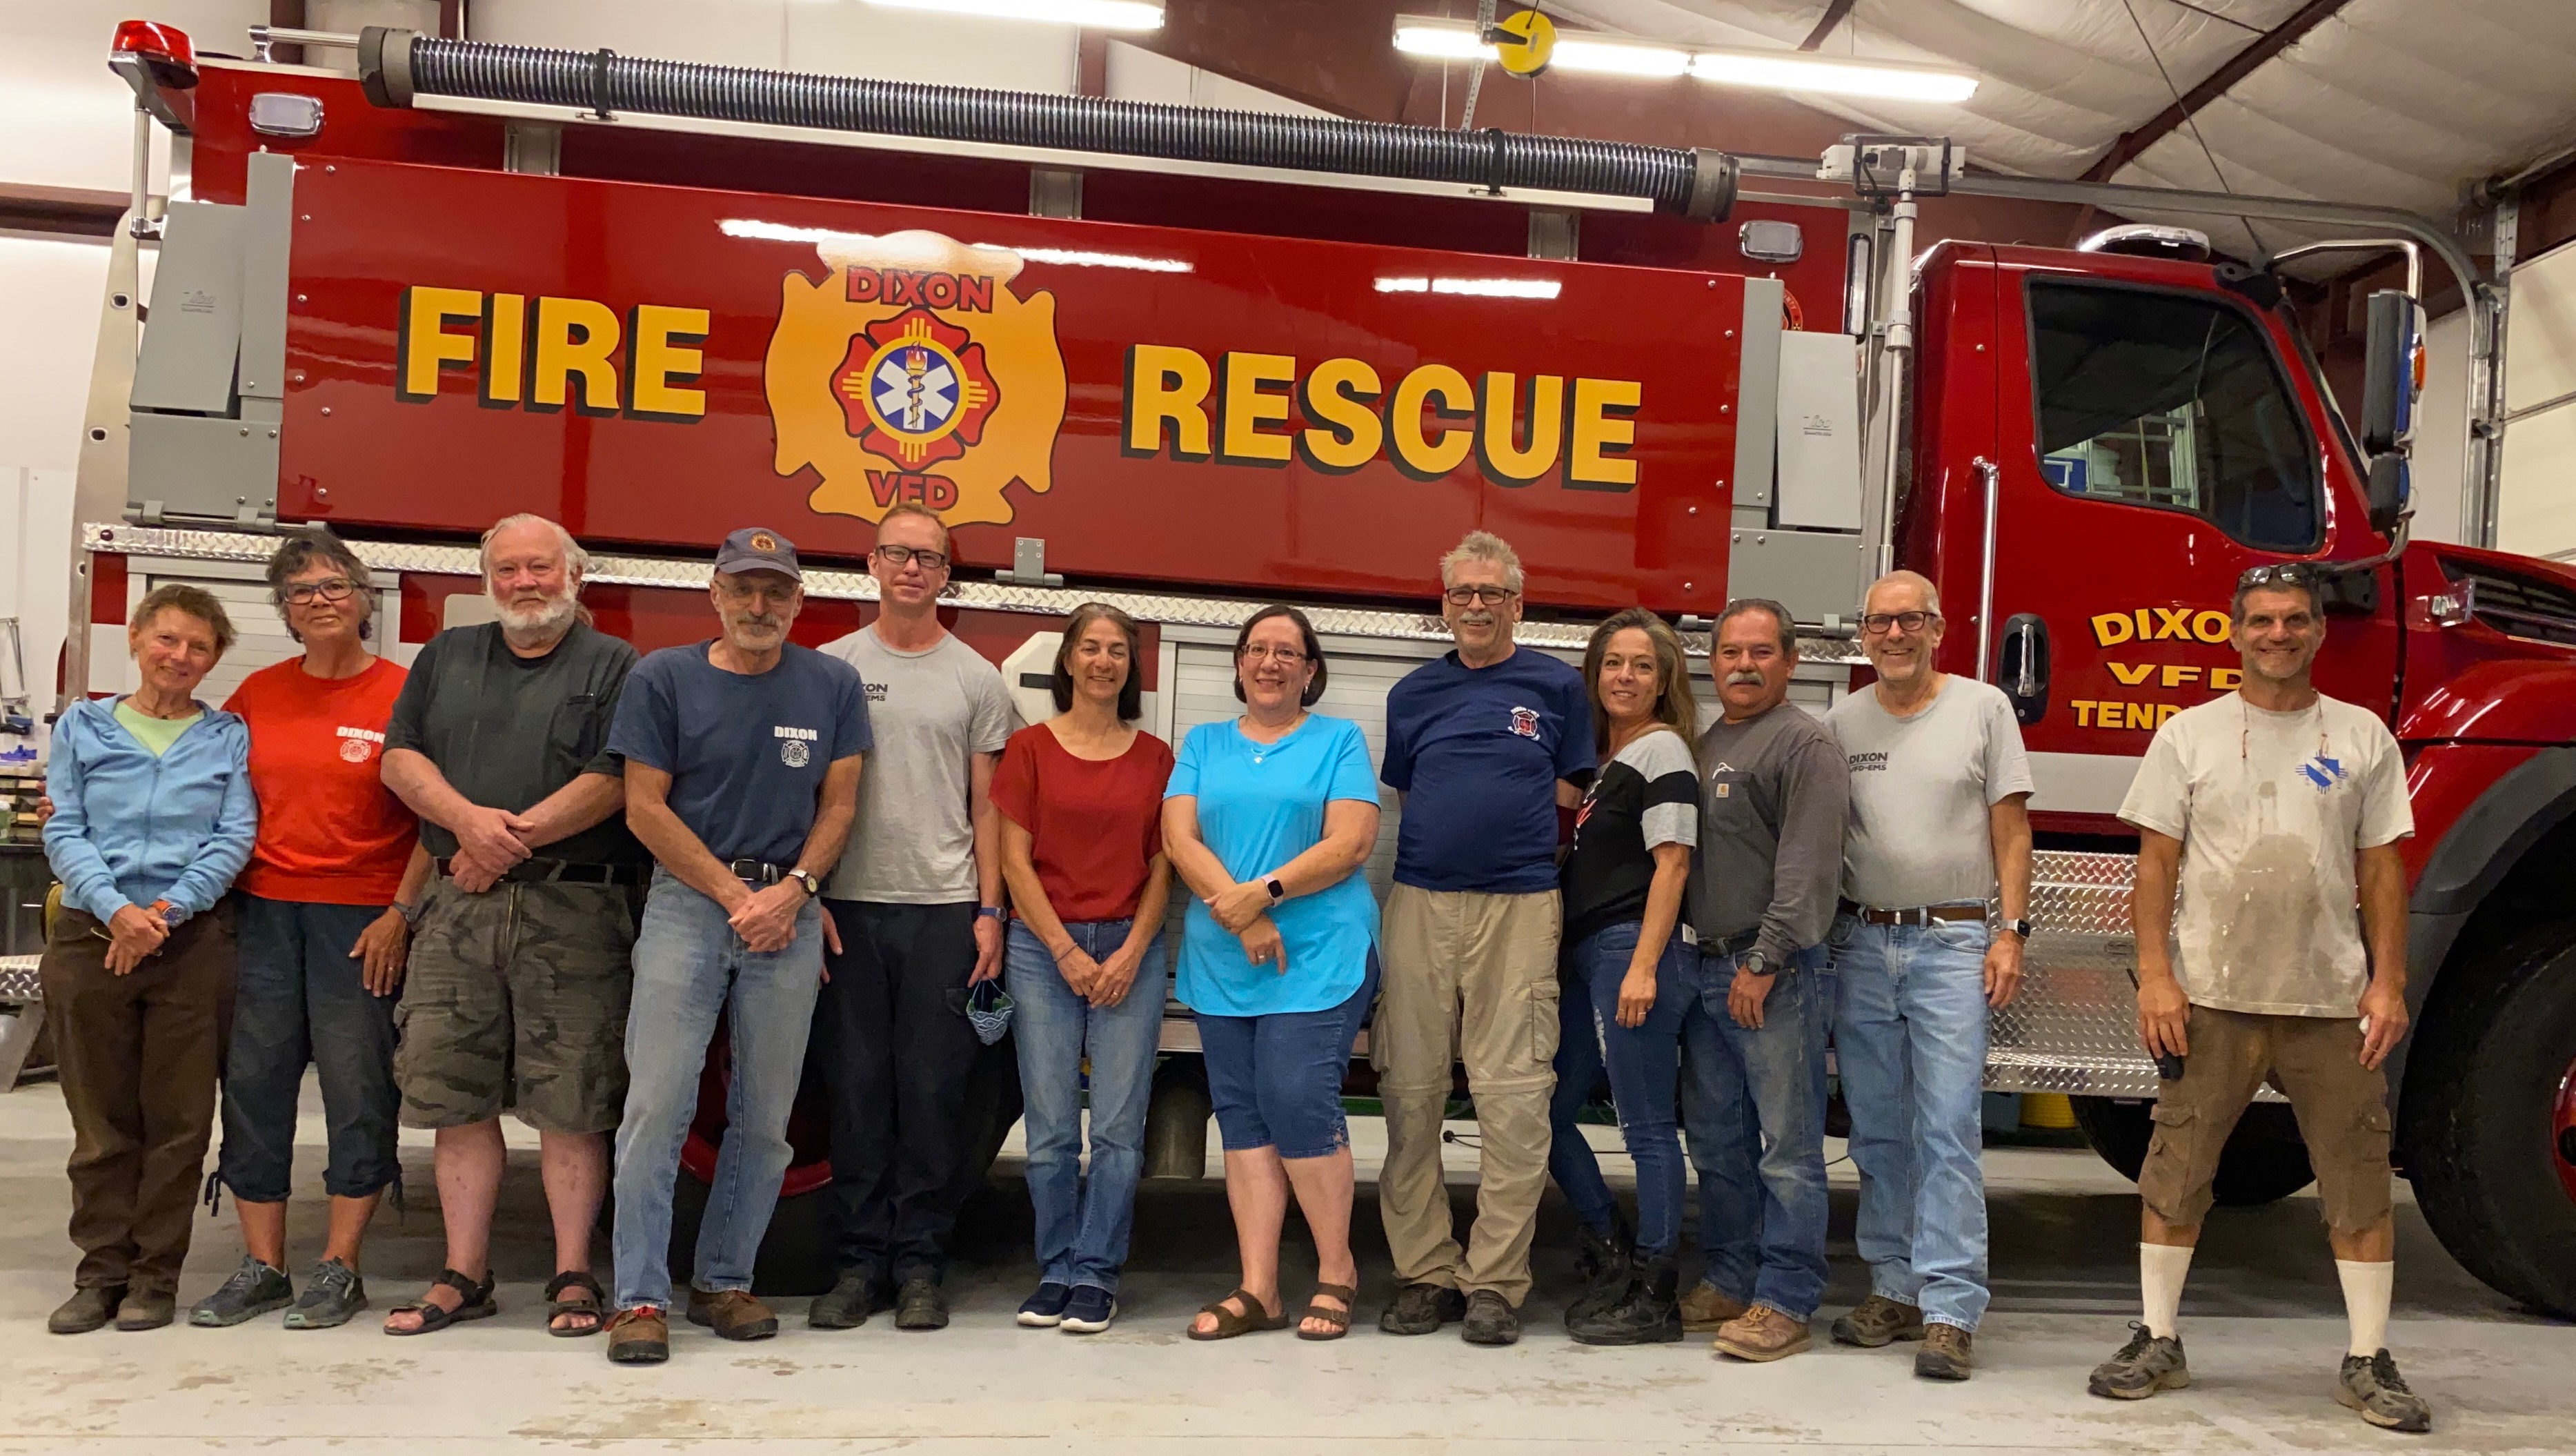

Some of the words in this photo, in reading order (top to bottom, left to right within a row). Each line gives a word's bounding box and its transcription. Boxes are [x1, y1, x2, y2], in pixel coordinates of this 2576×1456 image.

[846, 265, 993, 313] DIXON
[397, 286, 710, 422] FIRE
[1122, 344, 1642, 491] RESCUE
[864, 469, 959, 511] VFD
[2090, 607, 2232, 647] DIXO
[2106, 662, 2242, 689] VFD
[2070, 700, 2194, 730] TEND
[336, 726, 386, 744] DIXON
[774, 726, 818, 741] DIXON
[1849, 752, 1888, 765] DIXON
